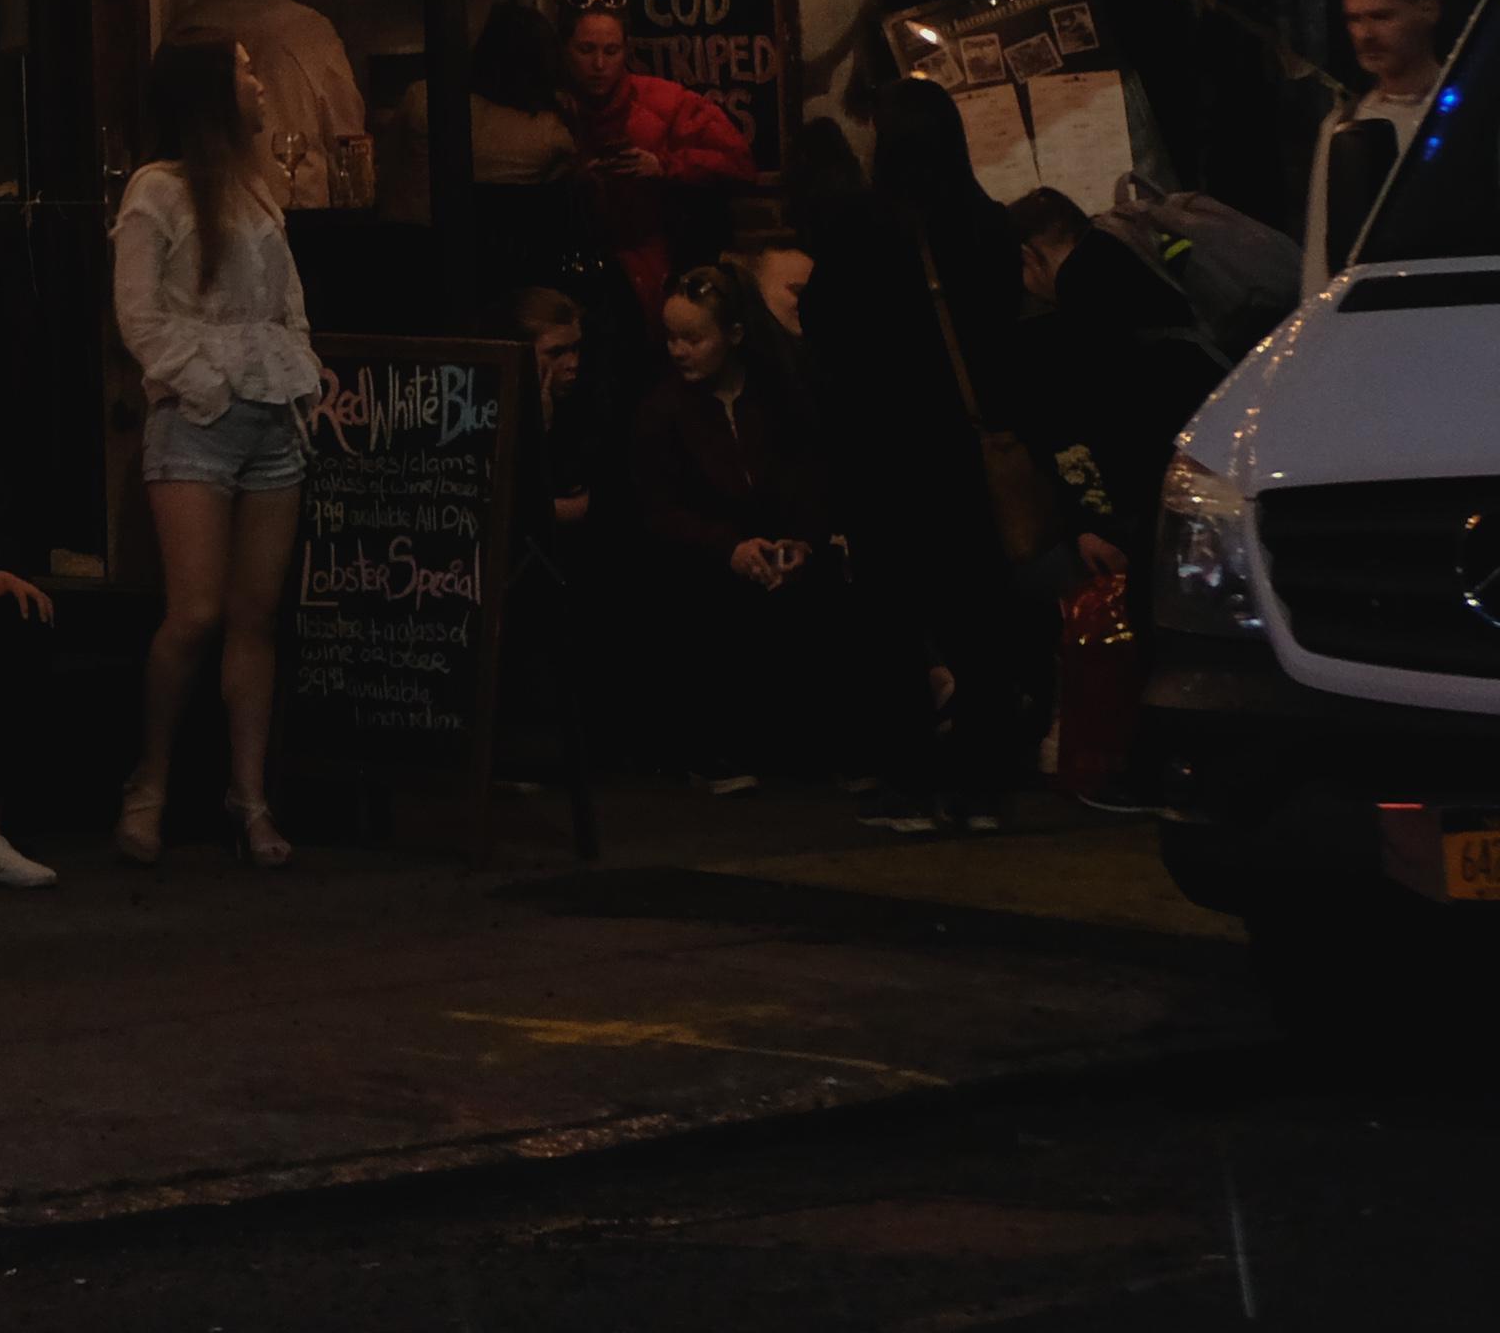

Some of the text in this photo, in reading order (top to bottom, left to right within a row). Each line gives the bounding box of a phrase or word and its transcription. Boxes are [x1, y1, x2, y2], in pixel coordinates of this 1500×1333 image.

[626, 34, 781, 85] STRIPED
[309, 367, 370, 455] Red
[366, 365, 439, 452] White
[436, 365, 498, 447] Blue
[389, 536, 481, 610] Special
